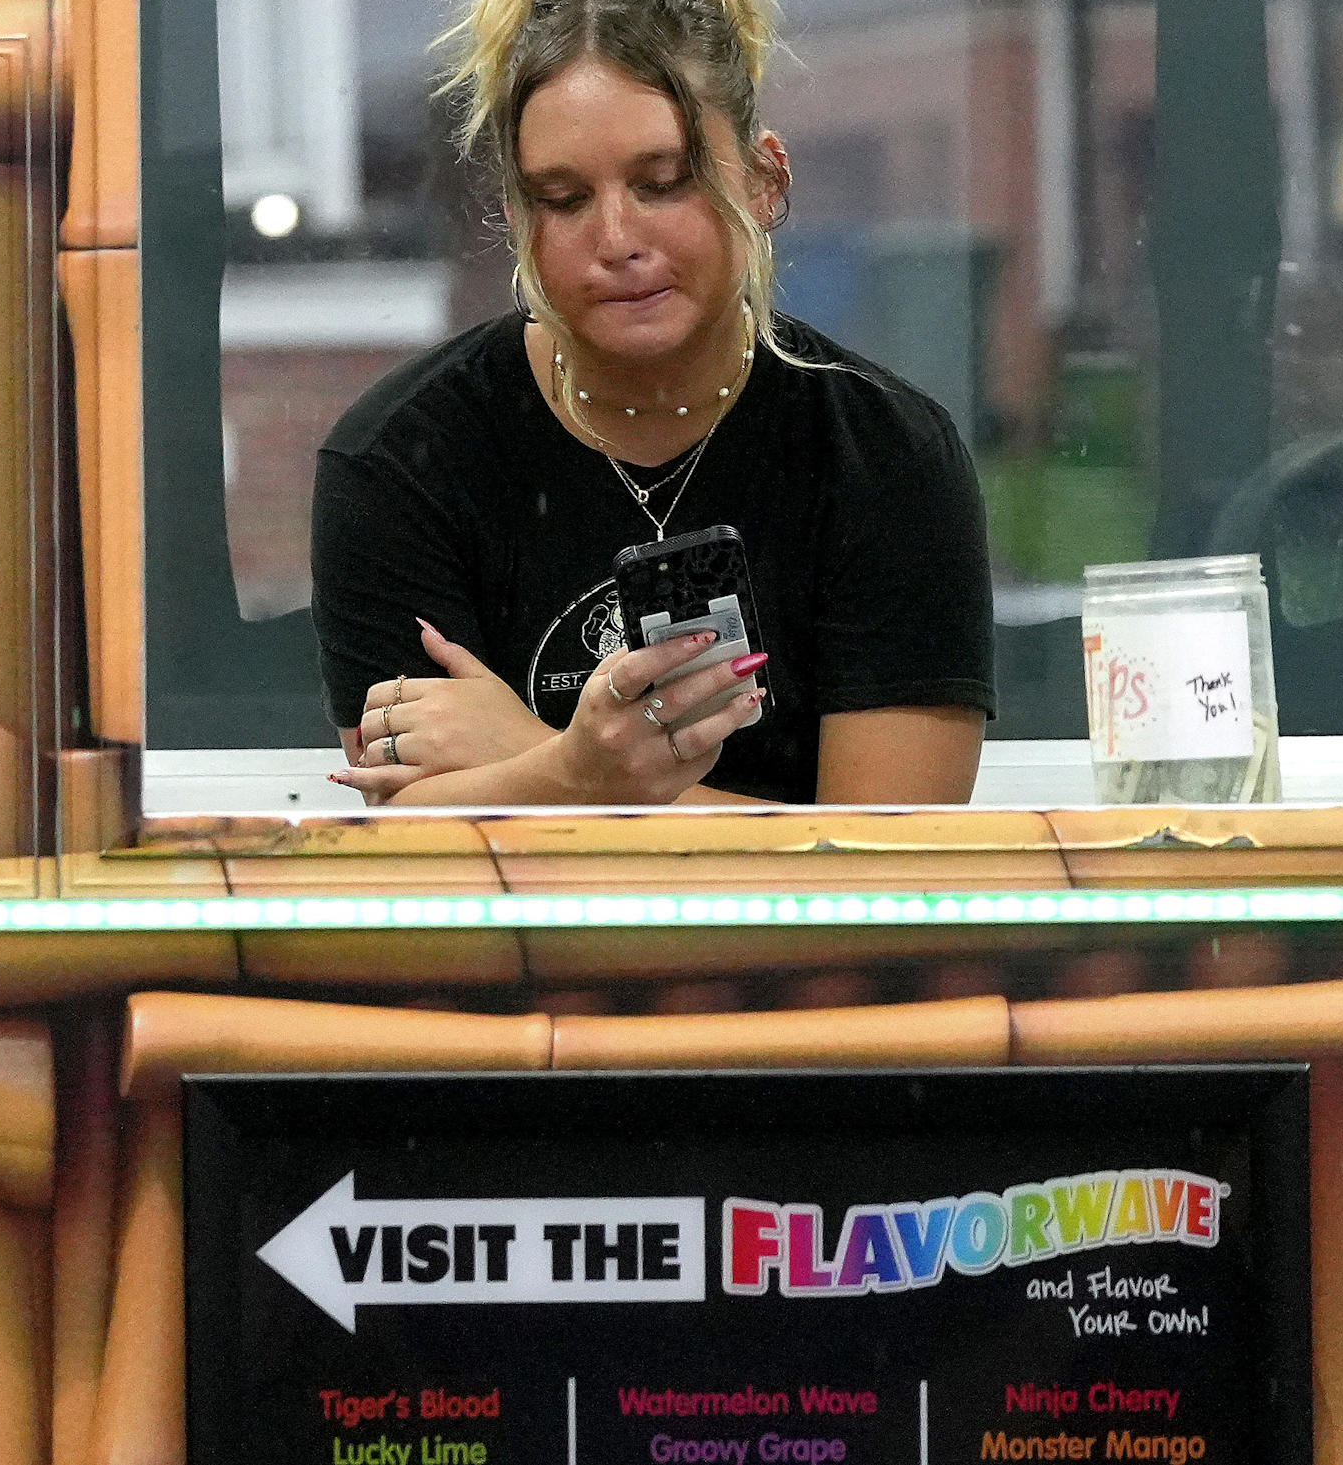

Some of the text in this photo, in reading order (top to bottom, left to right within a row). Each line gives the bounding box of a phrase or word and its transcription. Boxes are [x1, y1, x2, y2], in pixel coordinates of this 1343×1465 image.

[550, 674, 583, 689] EST.
[1186, 672, 1233, 695] Thank
[1198, 692, 1239, 723] You!
[330, 1170, 1220, 1297] VISIT THE FLAVORWAVE
[1026, 1269, 1073, 1300] and
[320, 1388, 500, 1427] Tiger's Blood
[618, 1385, 878, 1417] Watermelon Wave
[1005, 1382, 1181, 1418] Ninja Cherry
[333, 1435, 488, 1465] Lucky Lime
[649, 1432, 847, 1465] Groovy Grape
[980, 1430, 1206, 1465] Monster Mango
